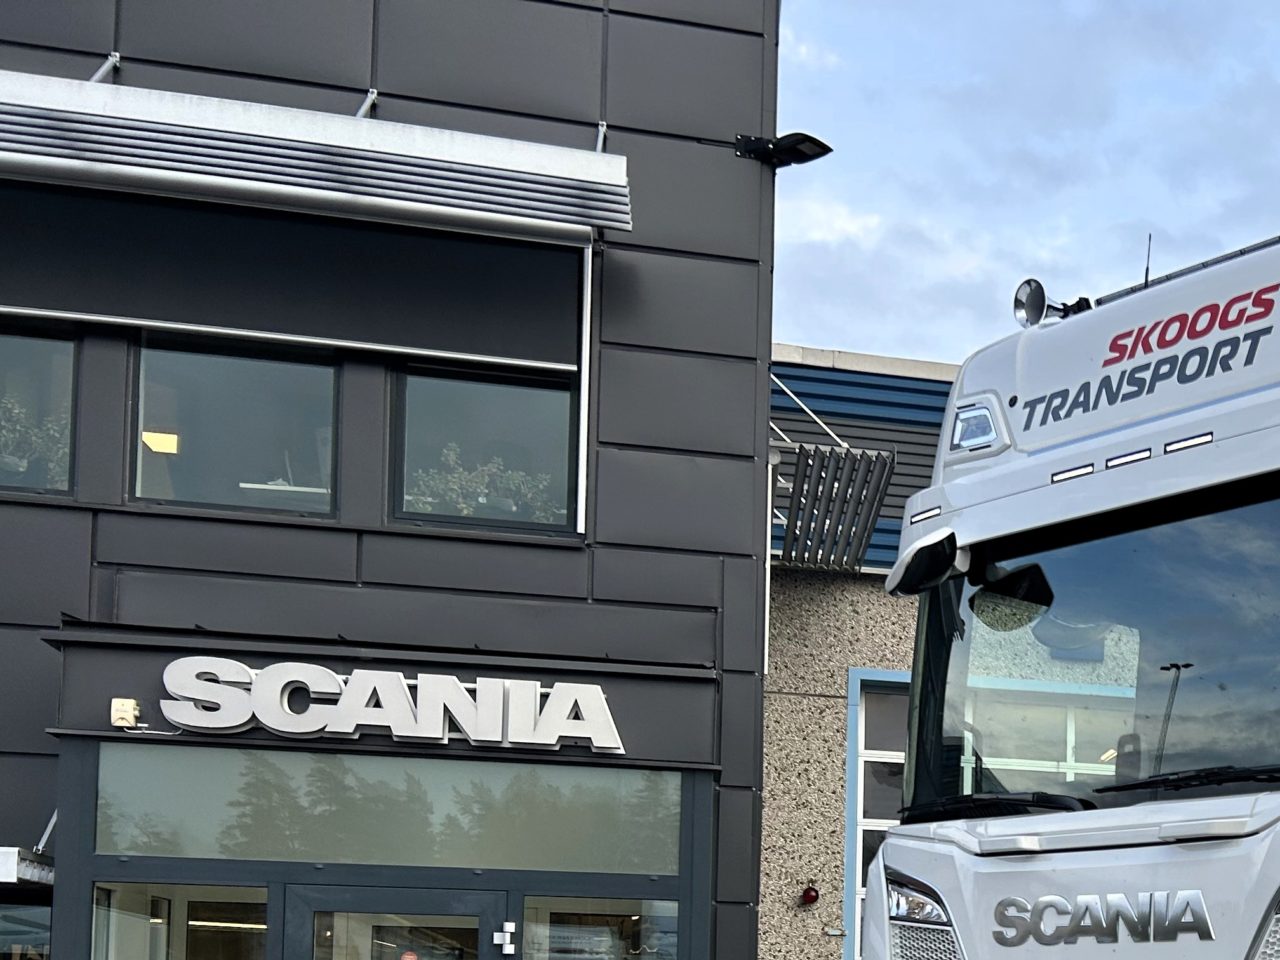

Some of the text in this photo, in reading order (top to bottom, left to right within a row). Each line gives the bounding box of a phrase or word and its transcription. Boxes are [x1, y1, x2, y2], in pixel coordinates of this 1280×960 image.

[1102, 282, 1280, 368] SKOOGS
[1022, 326, 1273, 432] TRANSPORT
[160, 655, 625, 754] SCANIA
[992, 889, 1216, 948] SCANIA
